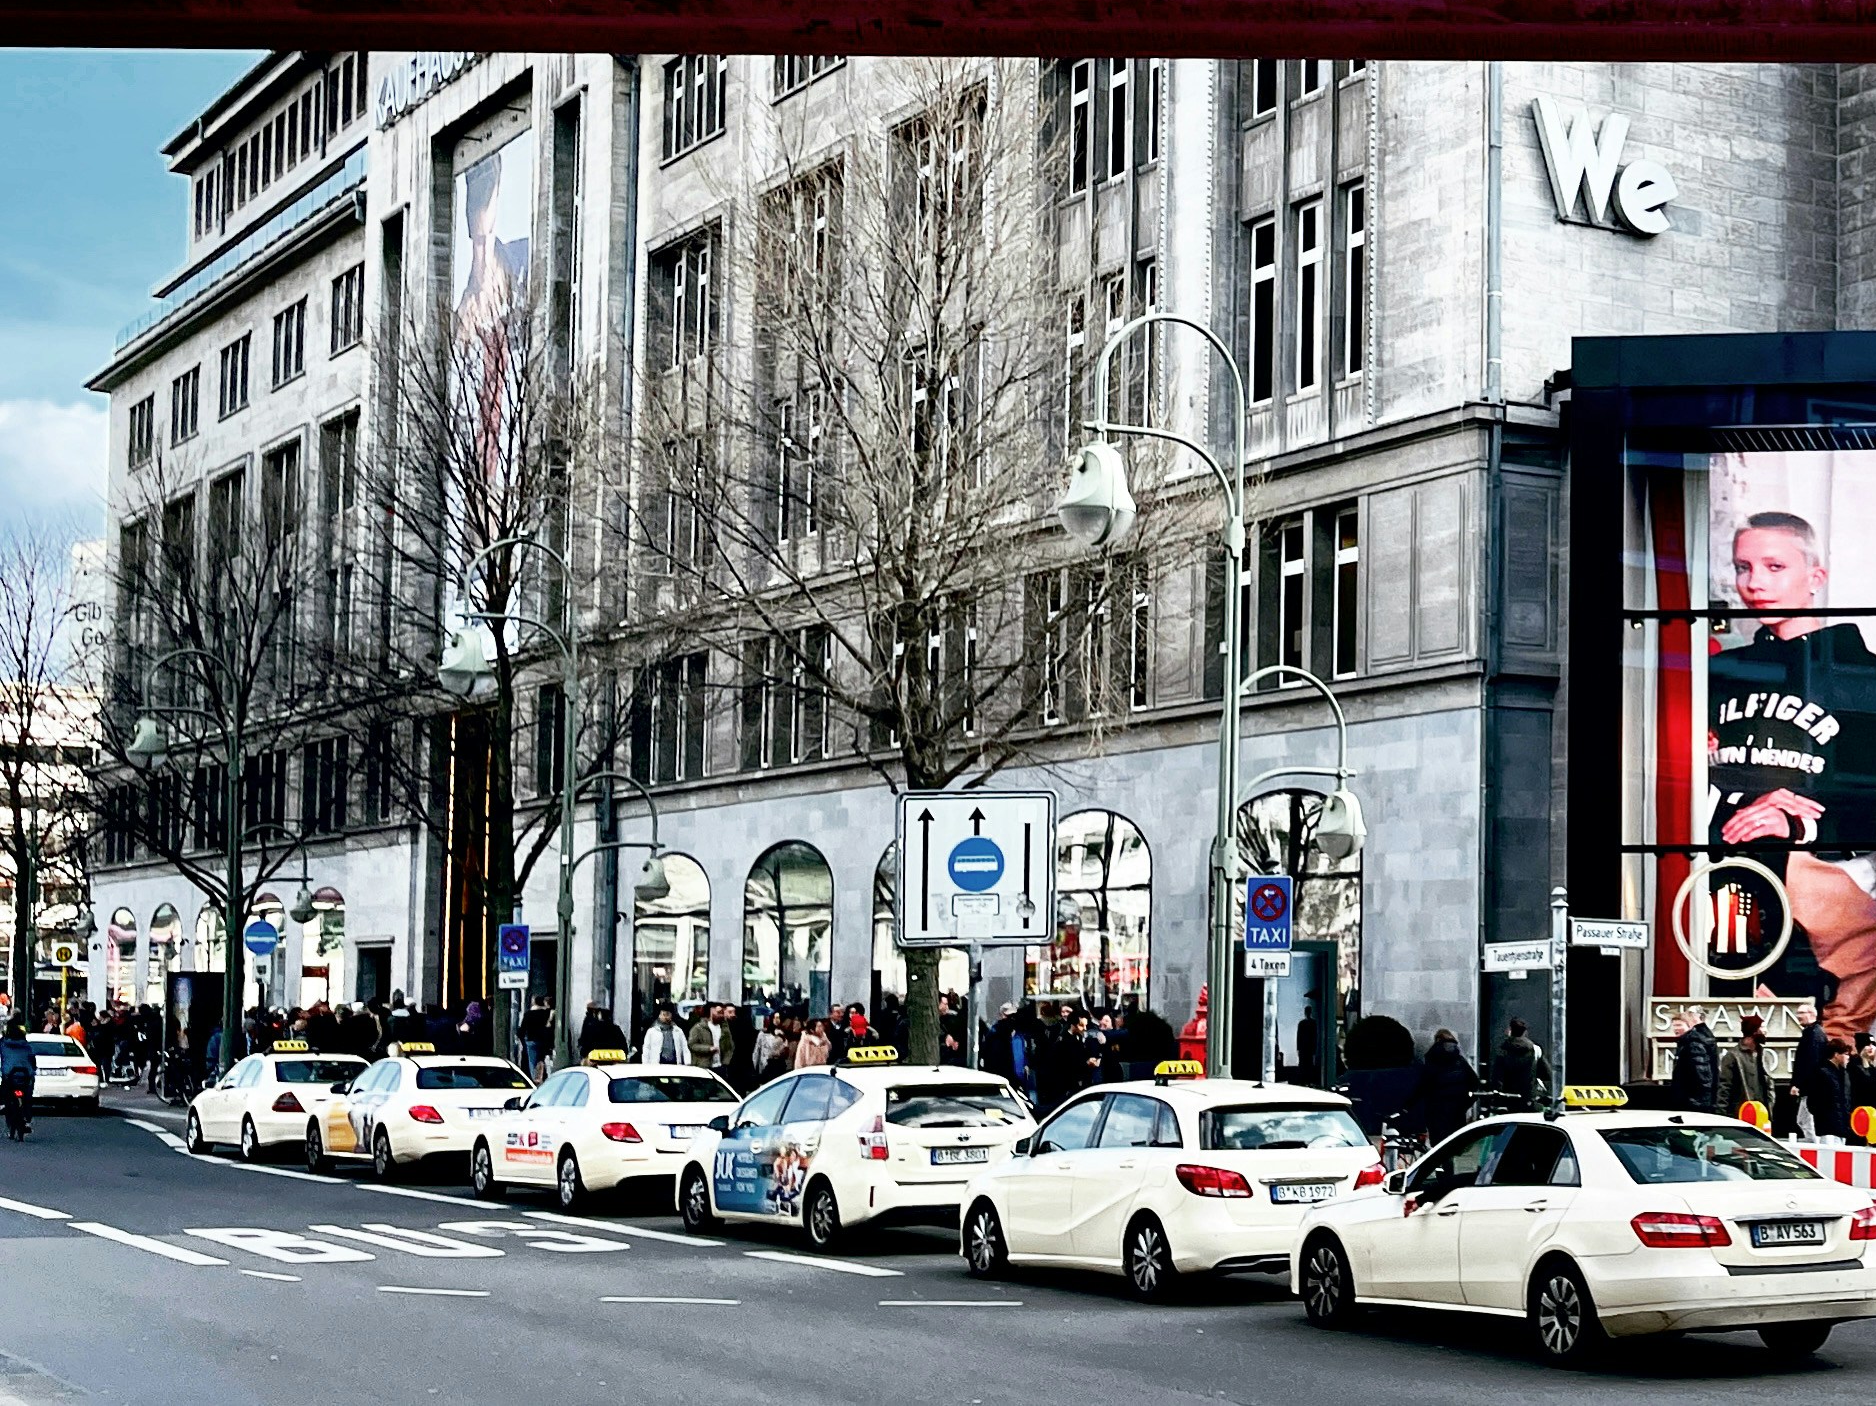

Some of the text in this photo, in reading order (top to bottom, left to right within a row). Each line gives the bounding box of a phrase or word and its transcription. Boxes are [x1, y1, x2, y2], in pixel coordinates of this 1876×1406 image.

[1532, 96, 1679, 236] We
[1750, 747, 1826, 774] MENDES
[1249, 927, 1287, 944] TAXI
[1576, 924, 1643, 943] Passauer Straße
[1259, 958, 1286, 970] Taxen
[1309, 1185, 1334, 1198] 1972
[1760, 1225, 1769, 1241] B
[1793, 1223, 1816, 1239] 563
[183, 1221, 632, 1264] BUS
